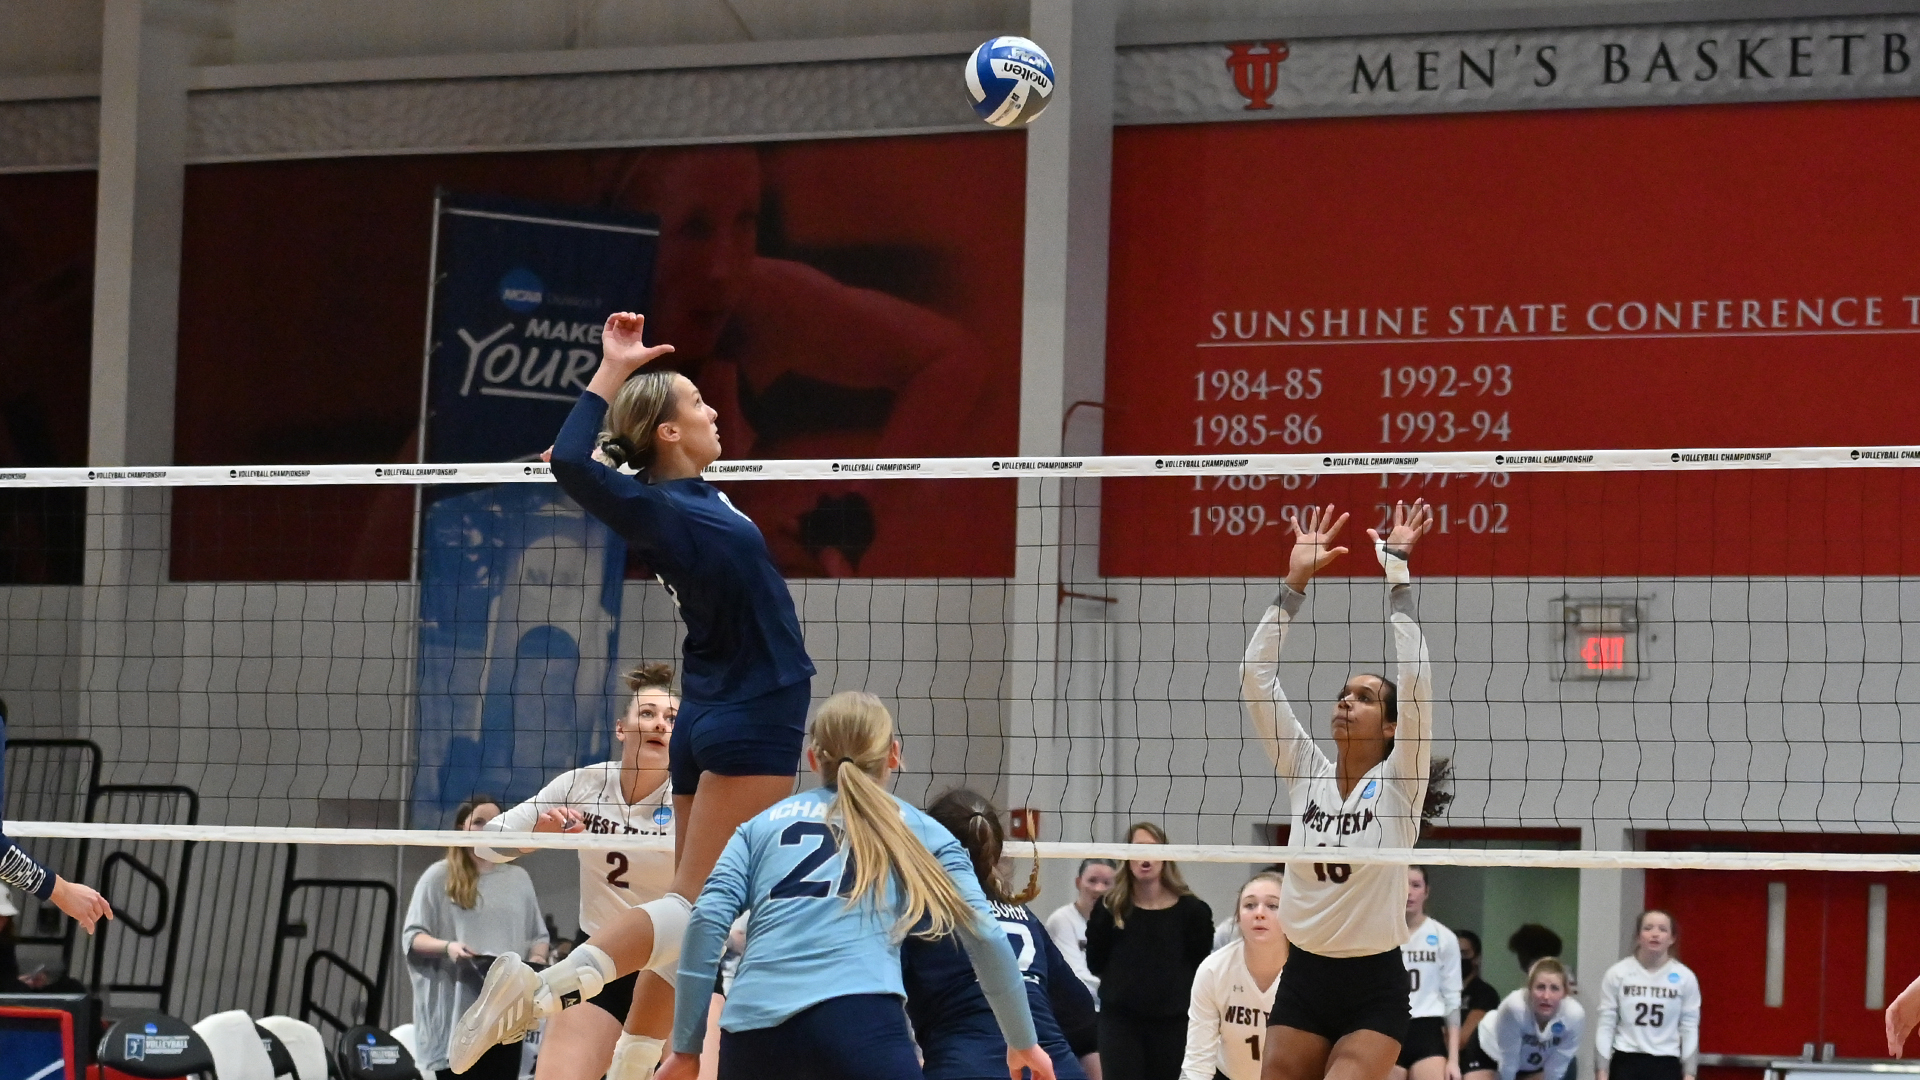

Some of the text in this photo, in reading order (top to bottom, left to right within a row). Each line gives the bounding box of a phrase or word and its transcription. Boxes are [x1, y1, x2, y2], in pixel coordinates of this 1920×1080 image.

[1003, 62, 1048, 88] molten
[1350, 32, 1911, 95] MEN'S BASKETB
[1210, 307, 1429, 340] SUNSHINE
[1448, 304, 1568, 334] STATE
[1586, 297, 1883, 331] CONFERENCE
[525, 318, 603, 345] MAKE
[457, 322, 598, 396] YOUR
[1194, 367, 1324, 401] 1984-85
[1379, 364, 1513, 398] 1992-93
[1193, 413, 1323, 447] 1985-86
[1379, 410, 1512, 445] 1993-94
[1001, 461, 1083, 470] VOLLEYBALL CHAMPIONSHIP
[1165, 459, 1249, 468] VOLLEYBALL CHAMPIONSHIP
[1333, 457, 1419, 466] VOLLEYBALL CHAMPIONSHIP
[1505, 455, 1594, 464] VOLLEYBALL CHAMPIONSHIP
[1681, 453, 1772, 462] VOLLEYBALL CHAMPIONSHIP
[1861, 451, 1899, 459] VOLLEYBALL
[383, 468, 458, 477] VOLLEYBALL CHAMPIONSHIP
[719, 465, 763, 473] CHAMPIONSHIP
[841, 463, 921, 472] VOLLEYBALL CHAMPIONSHIP
[1303, 800, 1335, 832] WEST
[606, 851, 629, 889] 2
[1623, 985, 1647, 997] WEST
[1225, 1005, 1260, 1027] WEST
[1635, 1003, 1664, 1027] 25
